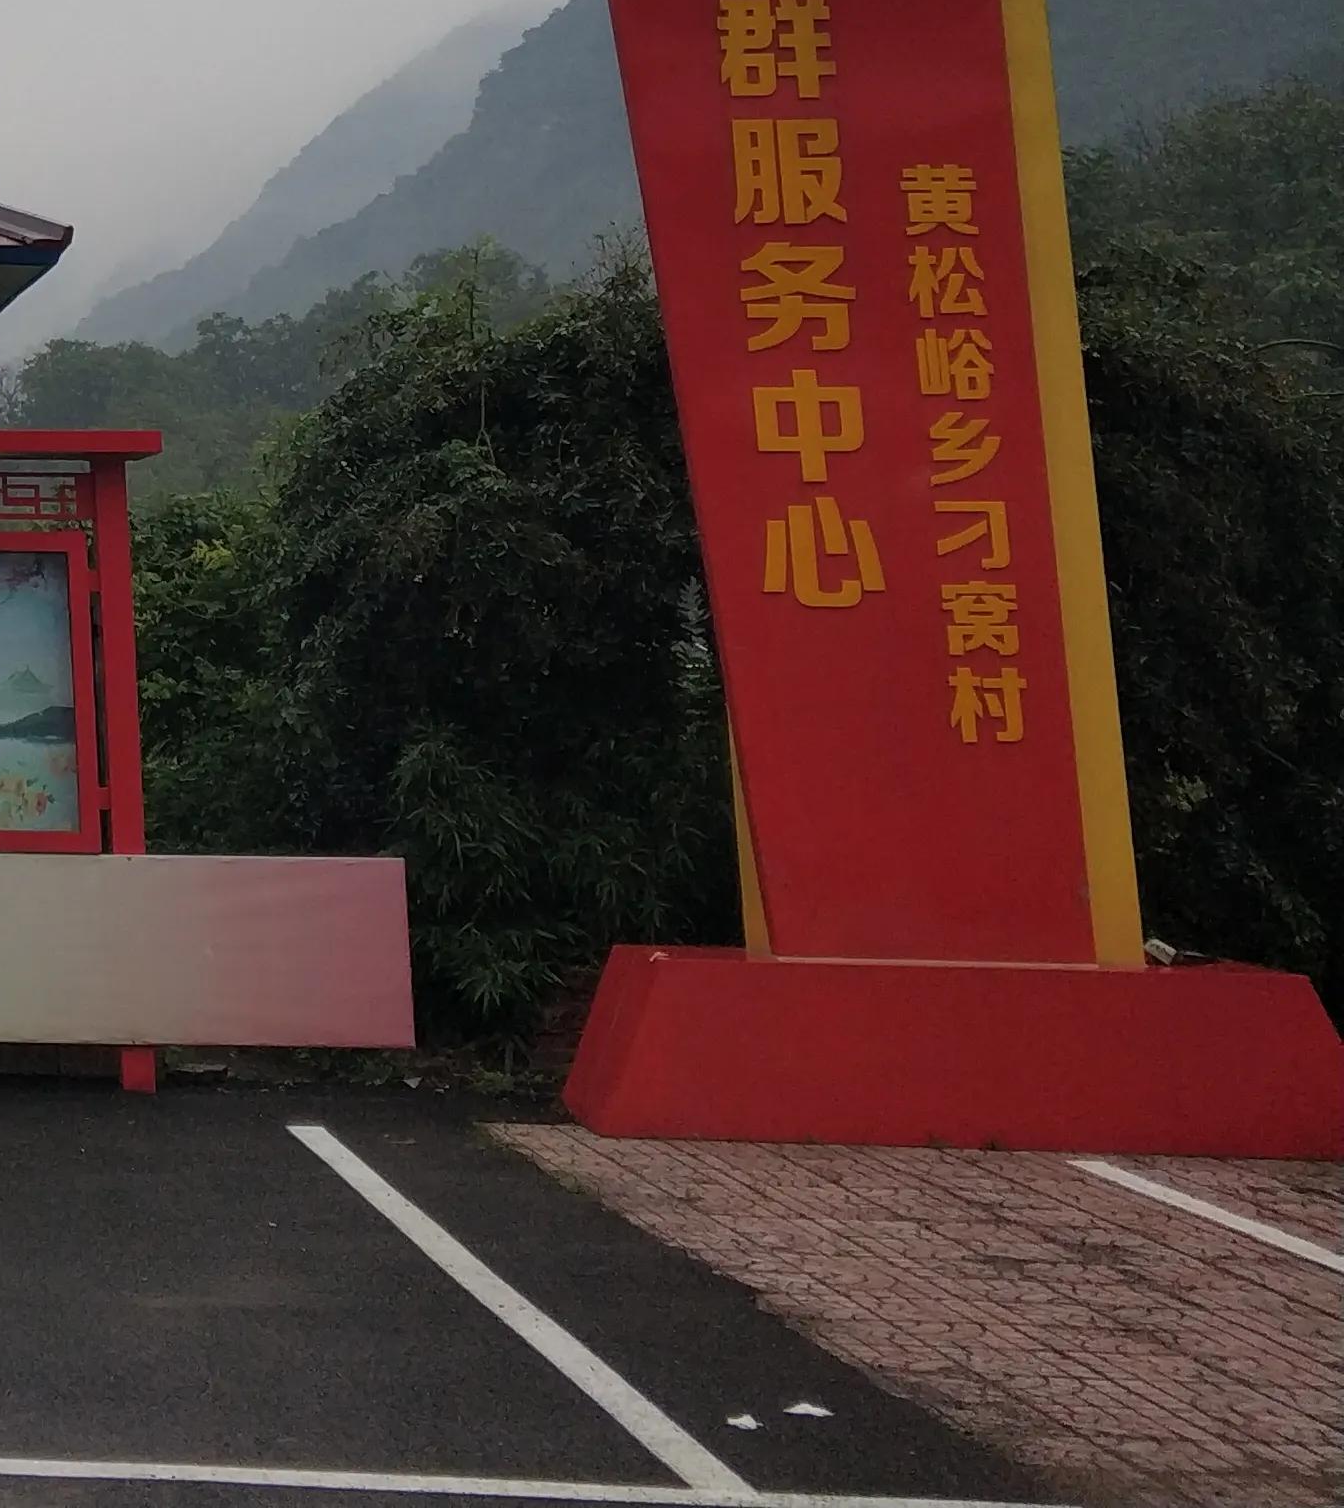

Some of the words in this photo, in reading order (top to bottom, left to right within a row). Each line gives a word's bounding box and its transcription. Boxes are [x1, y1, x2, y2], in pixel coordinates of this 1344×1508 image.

[898, 163, 1026, 746] 黄松峪乡刁窝村
